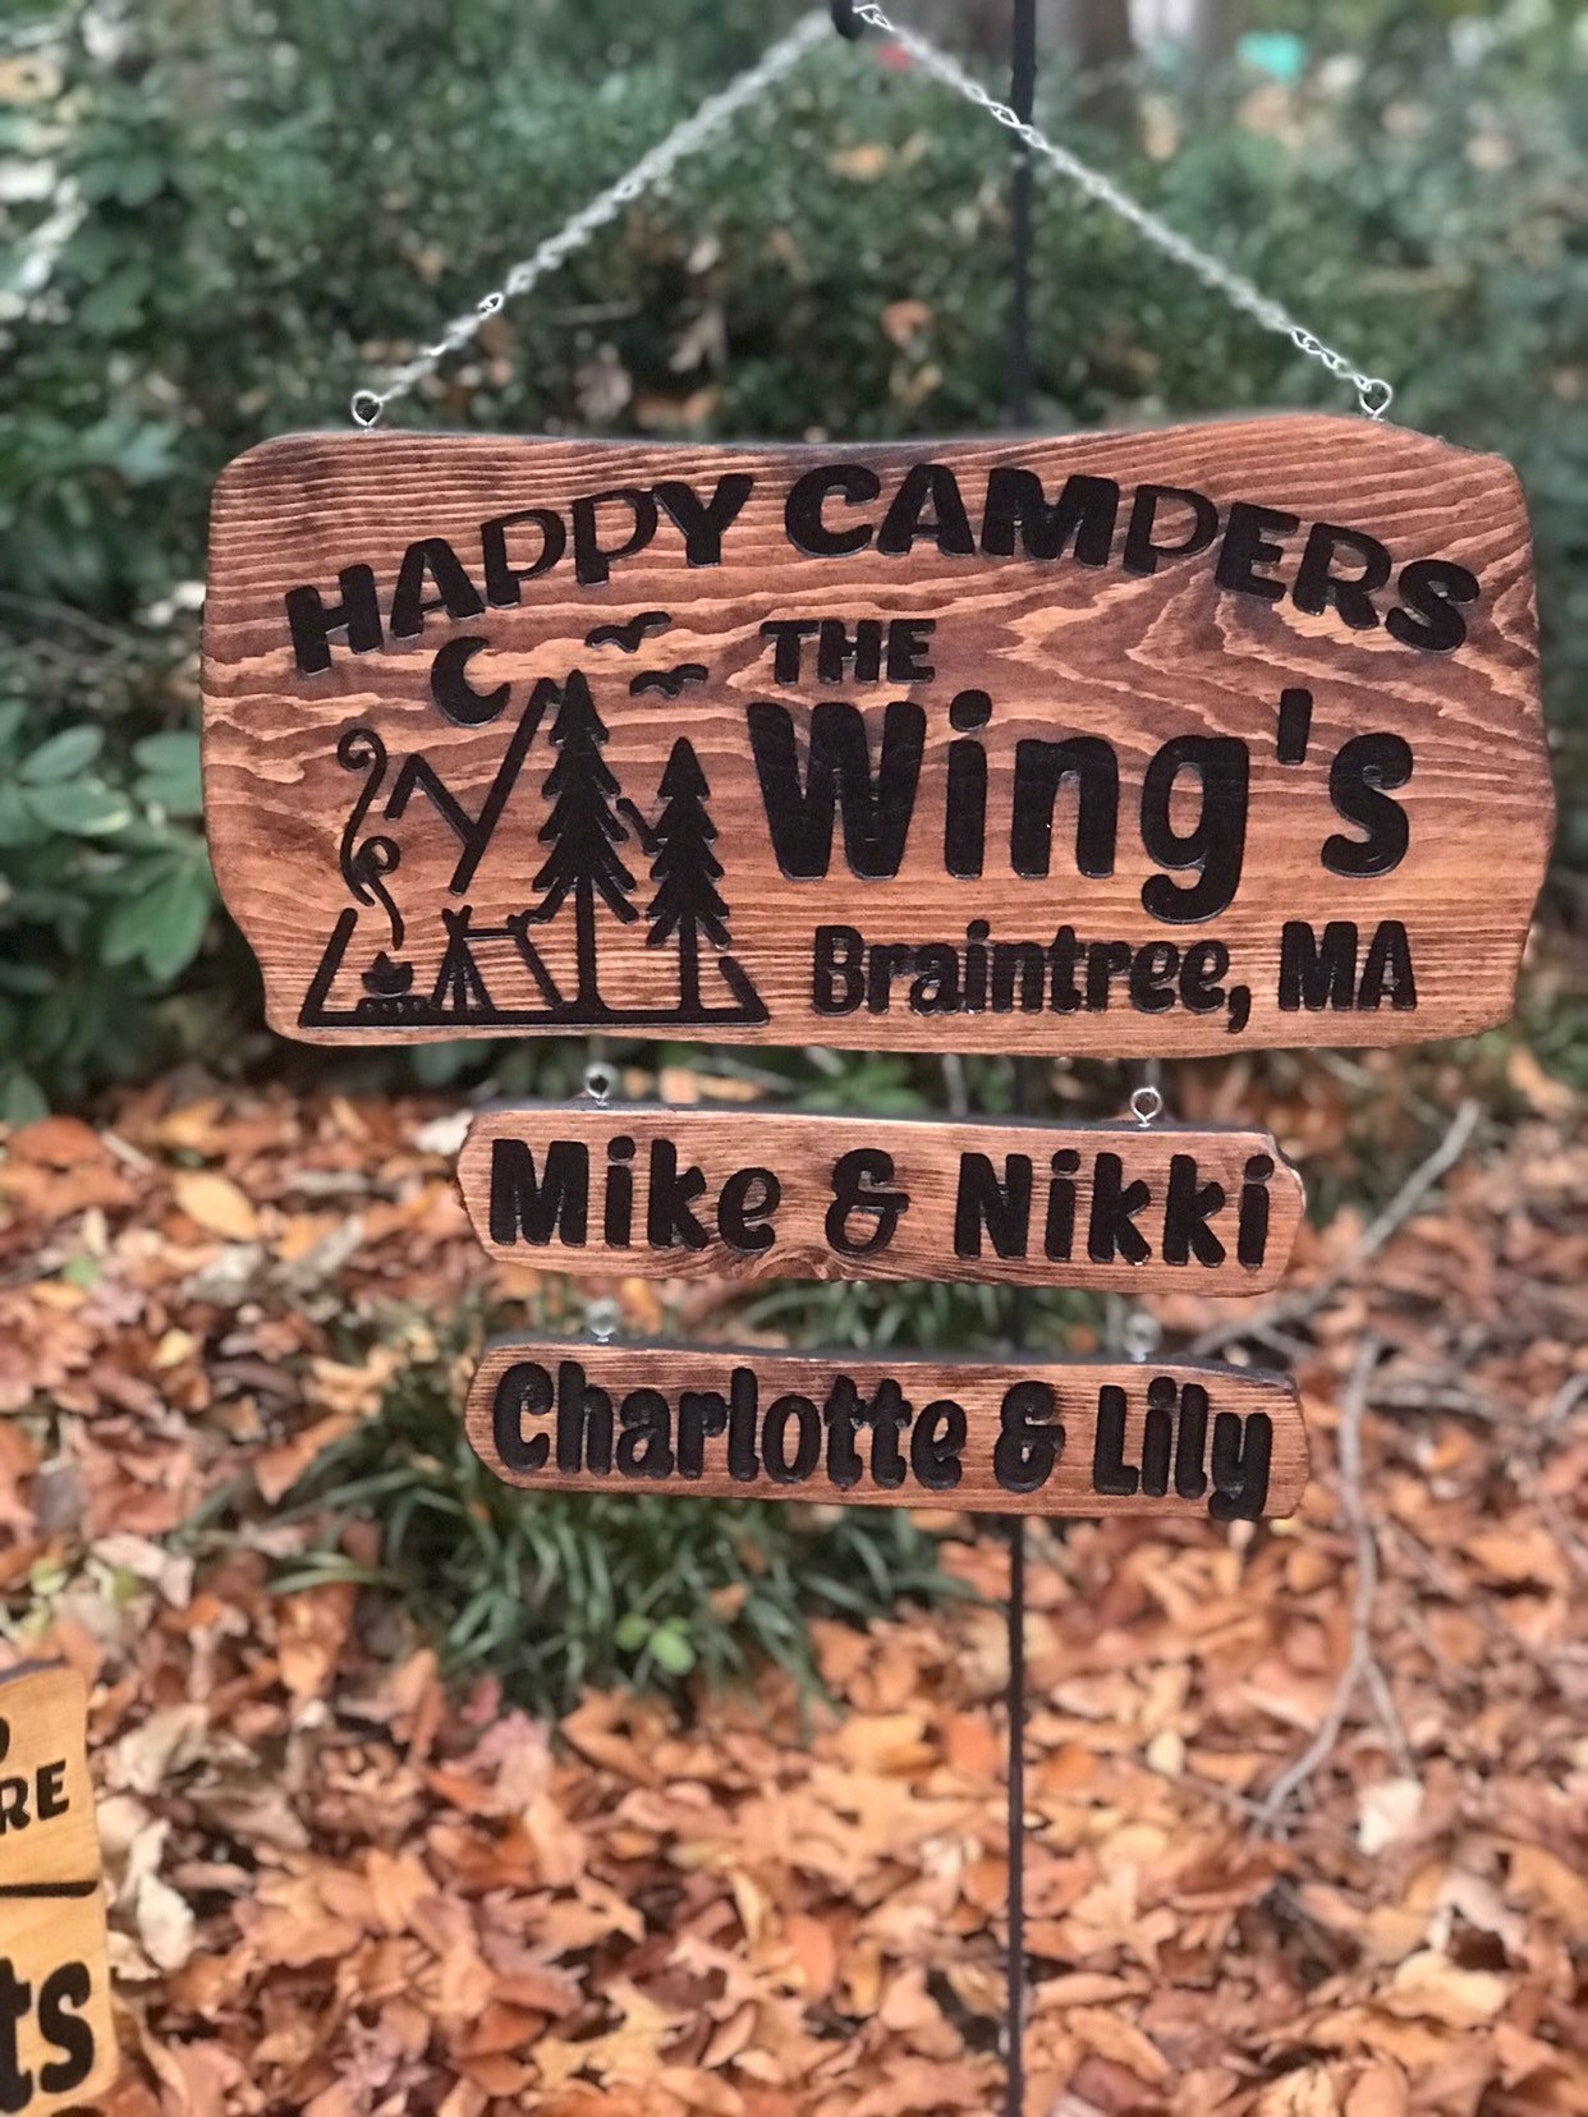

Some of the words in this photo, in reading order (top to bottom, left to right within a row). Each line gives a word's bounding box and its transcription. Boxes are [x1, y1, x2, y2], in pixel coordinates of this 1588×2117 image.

[285, 473, 753, 675] HAPPY
[784, 463, 1480, 653] CAMPERS
[759, 620, 936, 685] THE
[747, 688, 1414, 924] Wing's
[812, 920, 1250, 1034] Braintree,
[1278, 921, 1417, 1012] MA
[489, 1135, 782, 1254] Mike
[825, 1147, 909, 1258] &
[954, 1149, 1275, 1271] Nikki
[492, 1360, 967, 1490] Charlotte
[994, 1380, 1065, 1493] &
[1093, 1376, 1274, 1521] Lily
